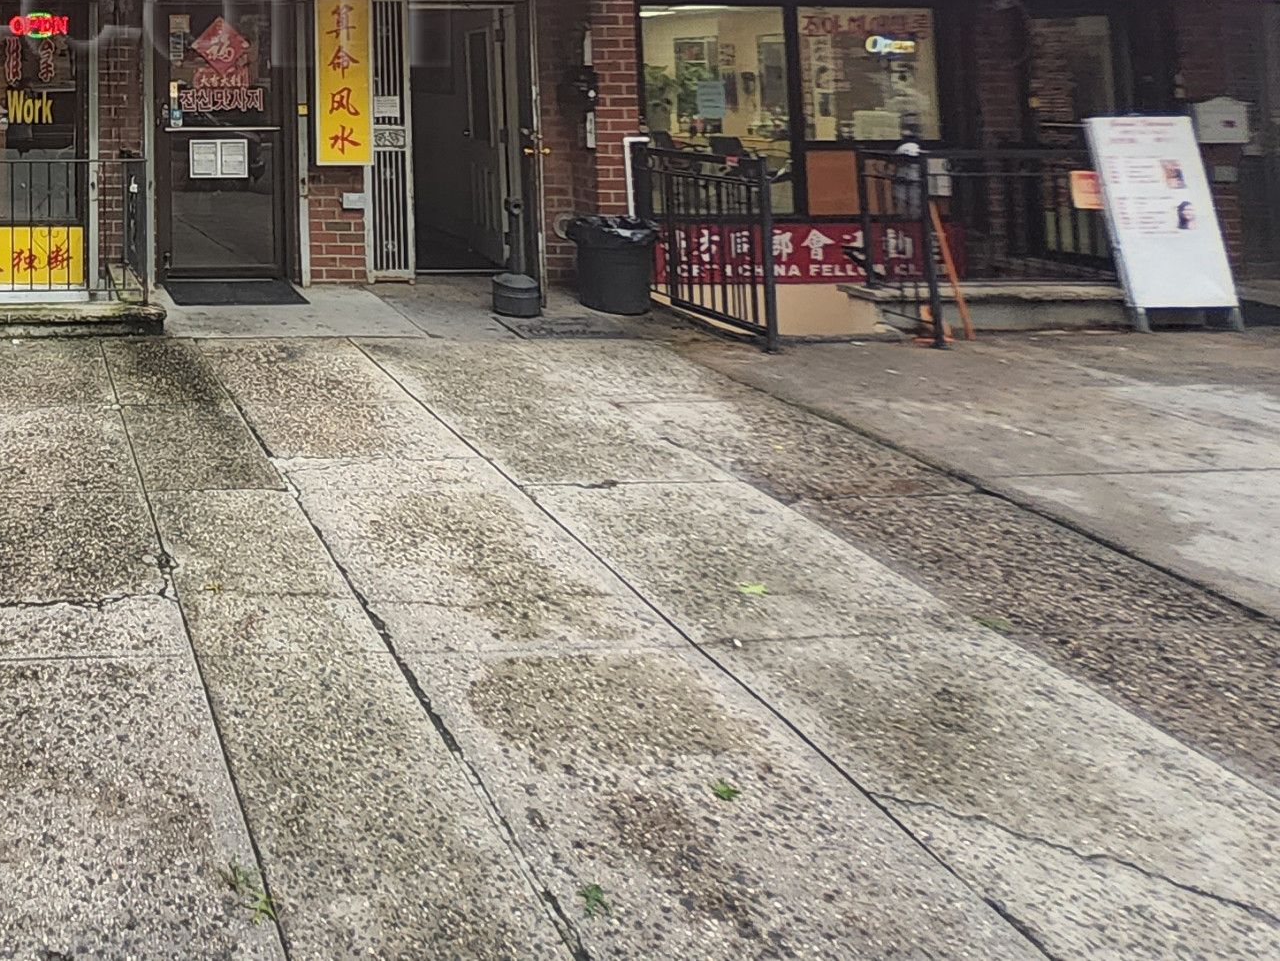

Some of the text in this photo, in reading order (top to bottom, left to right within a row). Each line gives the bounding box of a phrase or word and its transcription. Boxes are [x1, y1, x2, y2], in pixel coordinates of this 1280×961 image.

[8, 15, 69, 36] OPEN
[326, 3, 362, 155] 算命风水
[7, 90, 53, 124] Work
[738, 264, 802, 277] CHNA
